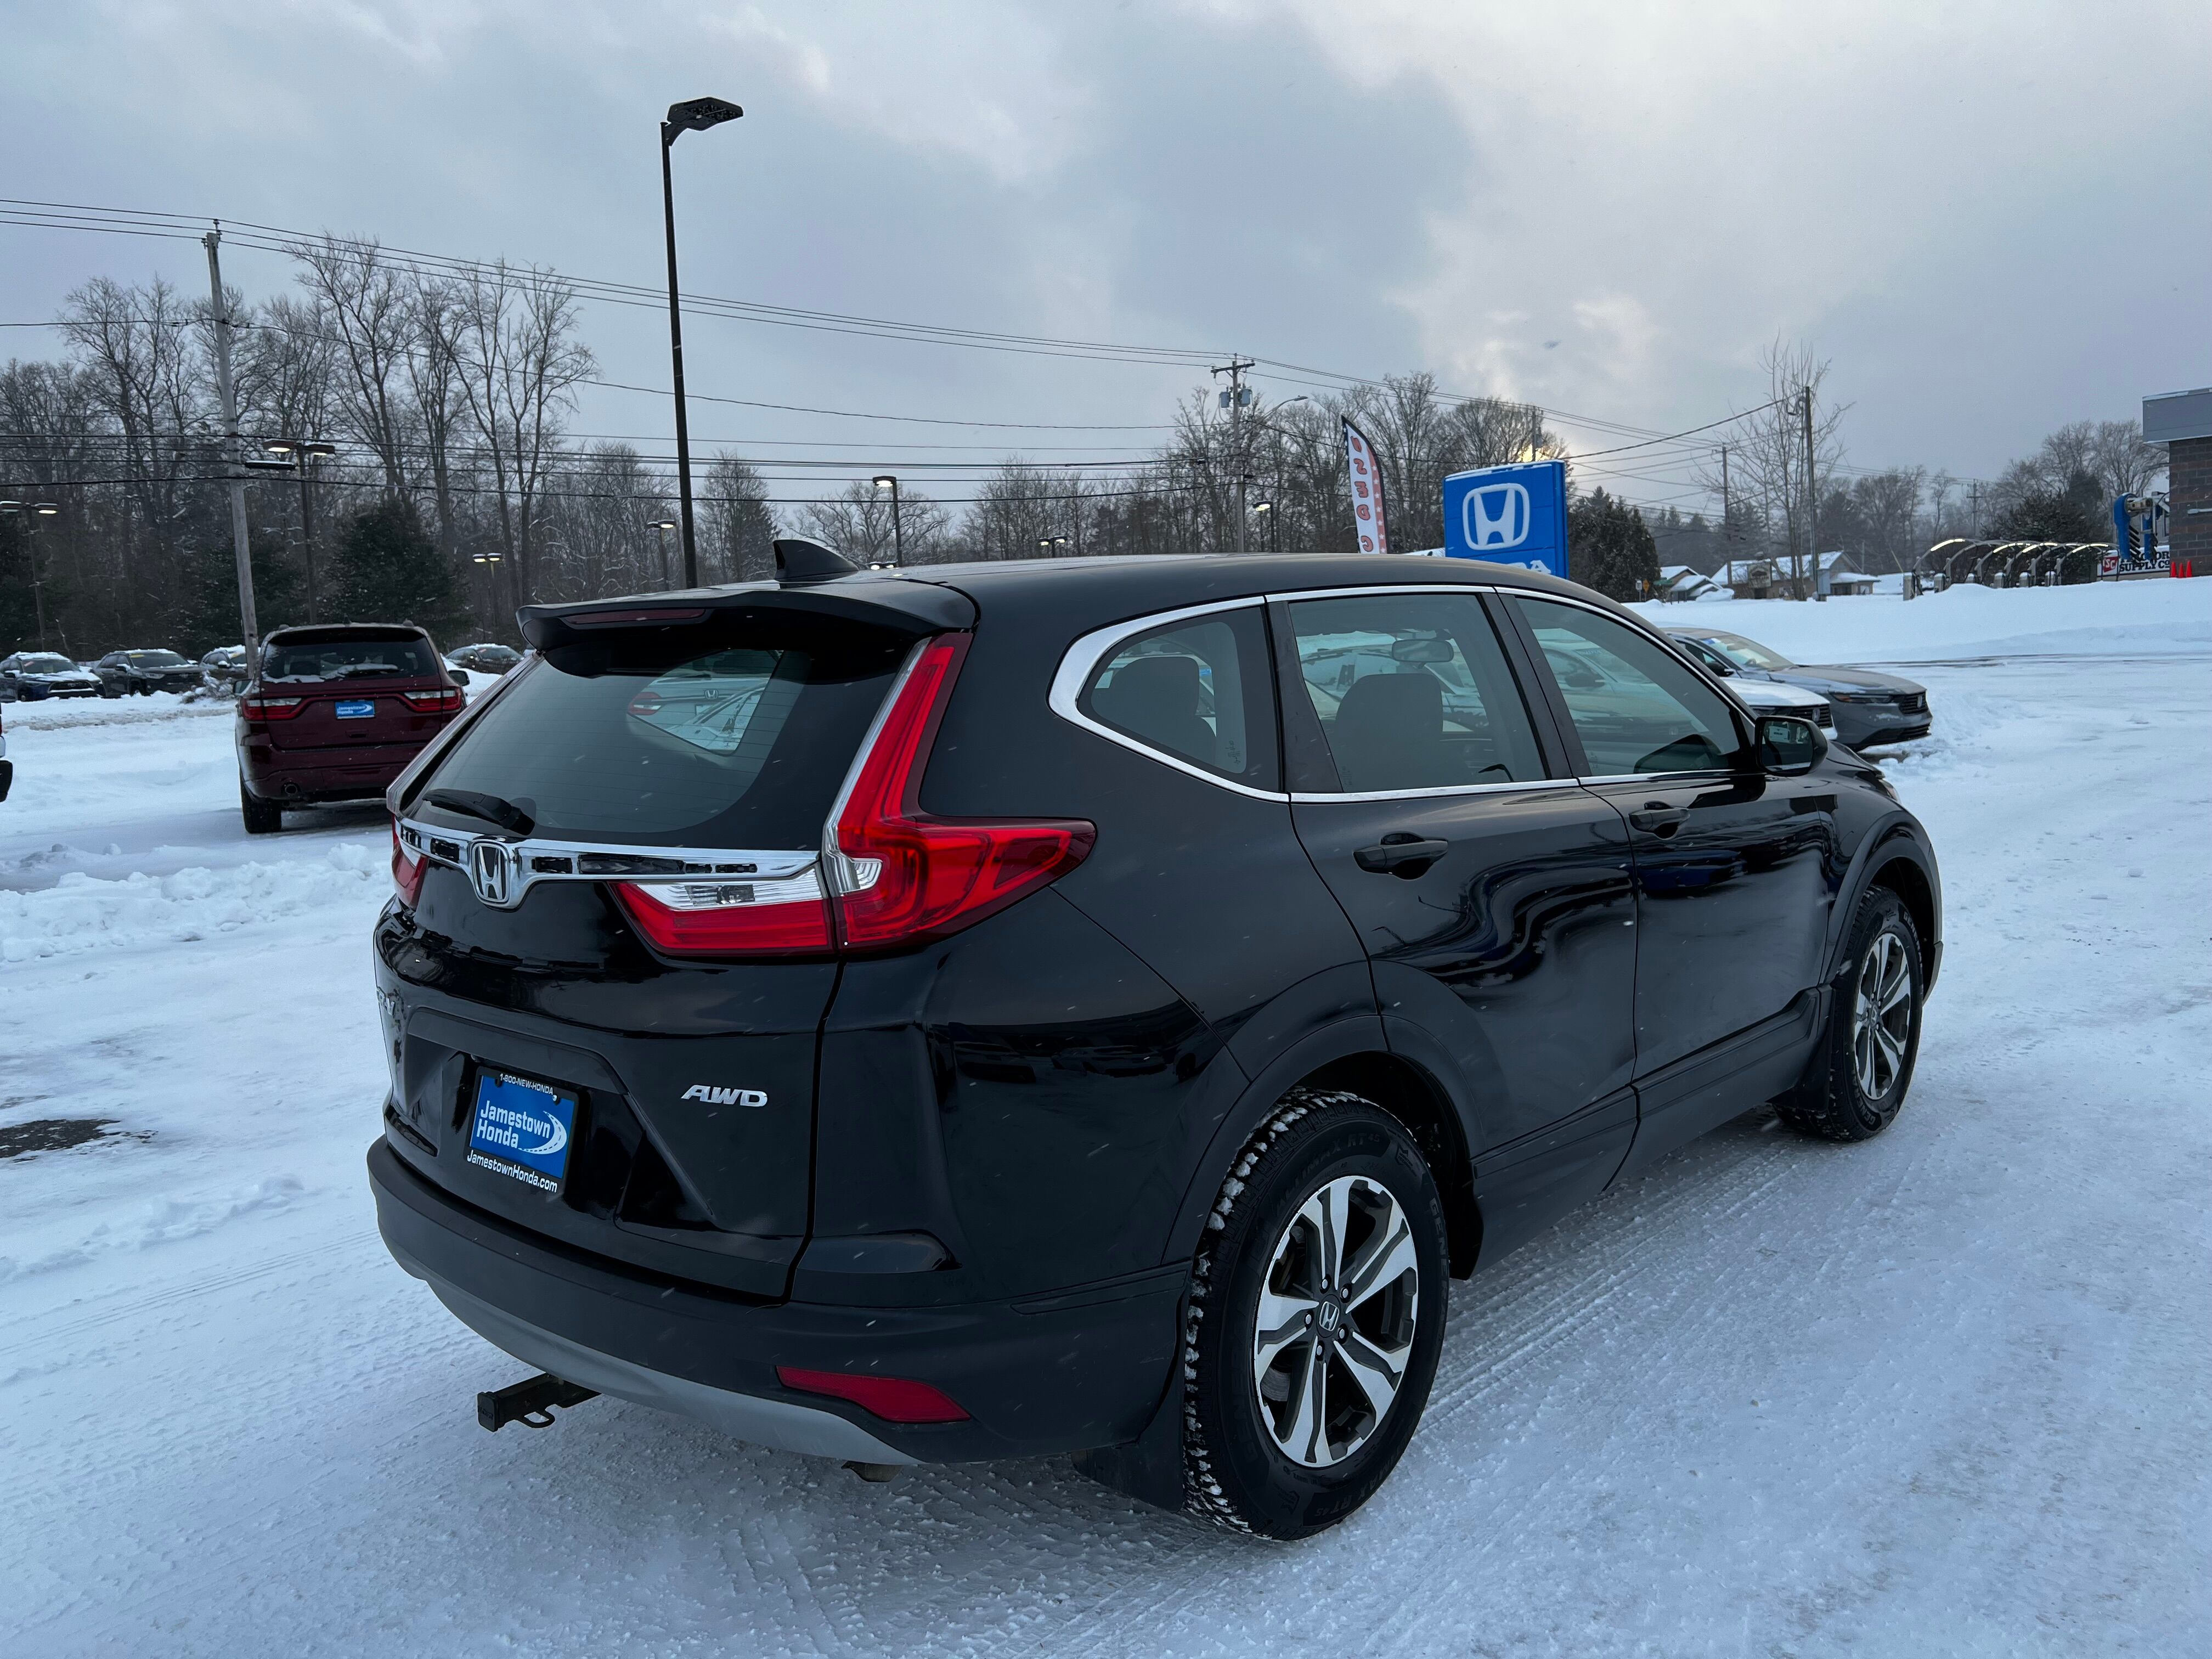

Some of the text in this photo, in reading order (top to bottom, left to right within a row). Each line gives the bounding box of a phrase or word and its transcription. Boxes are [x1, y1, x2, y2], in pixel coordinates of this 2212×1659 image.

[500, 1073, 554, 1095] 1-800-NEW-HONDA
[681, 1085, 768, 1107] AWD
[477, 1118, 519, 1149] Honda
[481, 1100, 551, 1139] Jamestown
[467, 1150, 558, 1193] JamestownHonda.com
